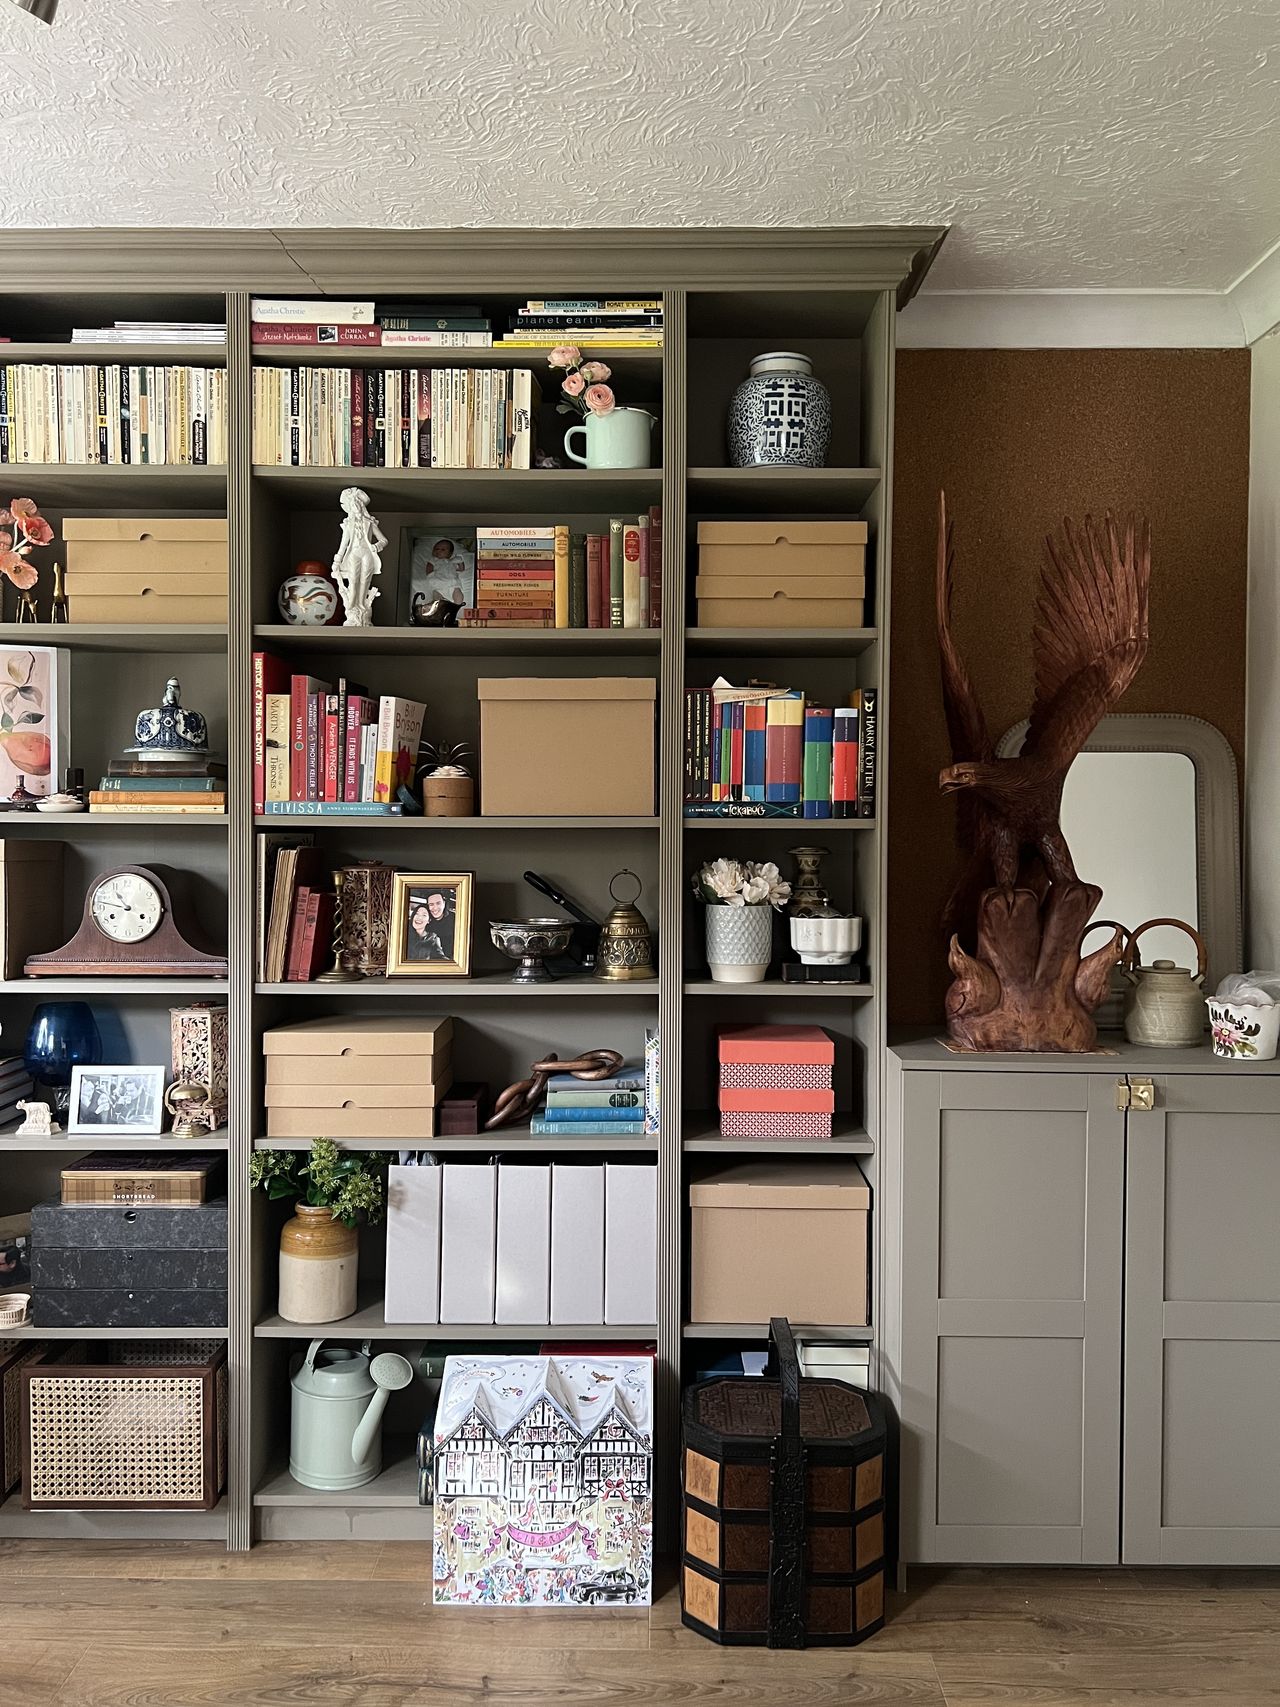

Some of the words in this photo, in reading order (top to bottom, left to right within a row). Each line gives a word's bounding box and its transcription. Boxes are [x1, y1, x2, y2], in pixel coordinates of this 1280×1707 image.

[255, 306, 279, 317] Agatha
[280, 306, 305, 315] Christie
[517, 317, 560, 325] planet
[566, 316, 602, 324] earth
[384, 335, 407, 343] Agatha
[519, 408, 530, 430] AGATHA
[420, 433, 428, 459] EVANS?
[255, 658, 263, 688] HISTORY
[255, 689, 263, 701] OF
[255, 702, 263, 717] THE
[270, 698, 279, 734] MARTIN
[383, 707, 391, 721] Bill
[405, 703, 416, 718] Bill
[328, 721, 337, 747] Arsène
[396, 712, 421, 735] Bryson
[864, 715, 876, 748] HARRY
[380, 722, 390, 749] Bryson
[255, 732, 263, 766] CENTURY
[309, 743, 317, 768] TIMOTHY
[270, 756, 279, 789] THRONES
[327, 748, 337, 781] WENGER
[863, 751, 876, 788] POTTER
[309, 769, 317, 788] KELLER
[347, 776, 355, 784] US
[272, 802, 323, 814] EIVISSA
